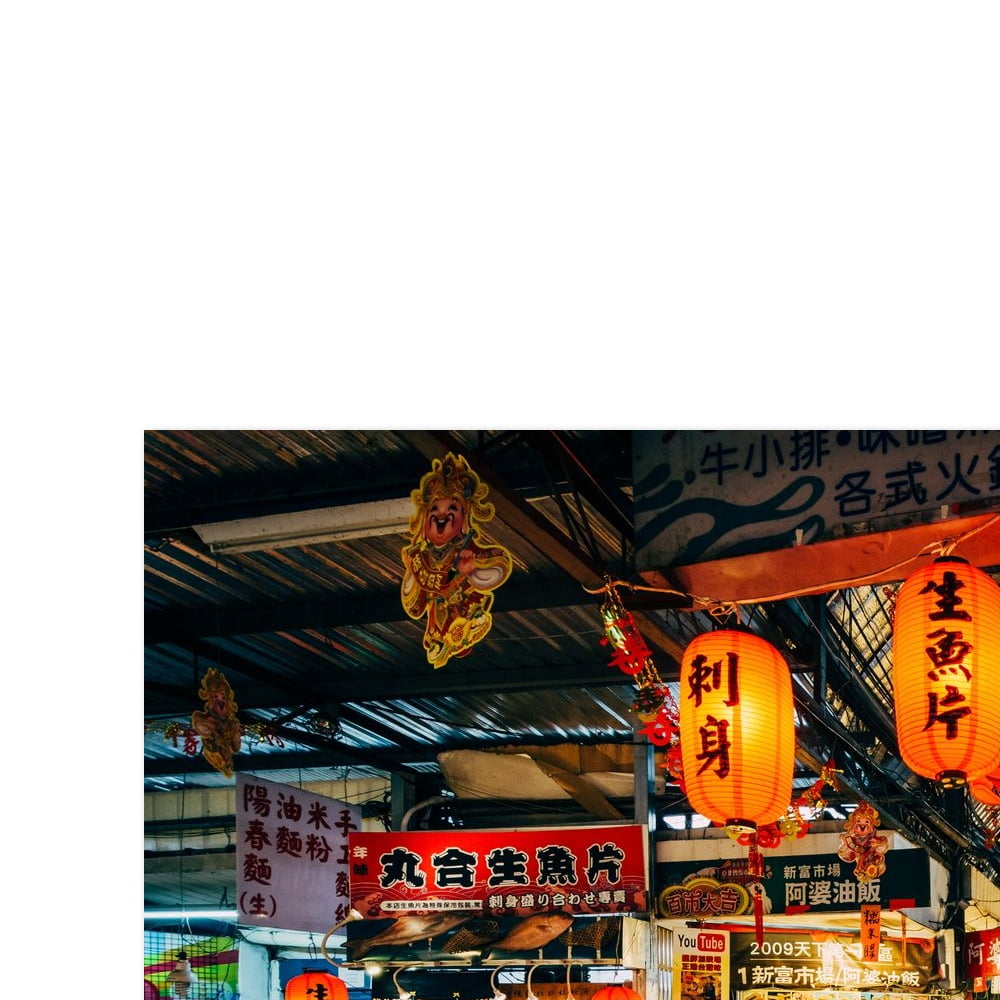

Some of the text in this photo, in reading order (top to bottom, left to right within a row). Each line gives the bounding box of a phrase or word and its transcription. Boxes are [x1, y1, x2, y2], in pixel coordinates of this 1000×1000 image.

[919, 571, 974, 740] 生魚片
[688, 652, 740, 779] 刺身
[243, 783, 272, 886] 陽春麵
[275, 793, 302, 858] 油麵
[305, 802, 333, 863] 米粉
[379, 842, 625, 888] 丸合生魚片
[783, 863, 842, 880] 新富市場
[785, 879, 882, 906] 阿婆油飯
